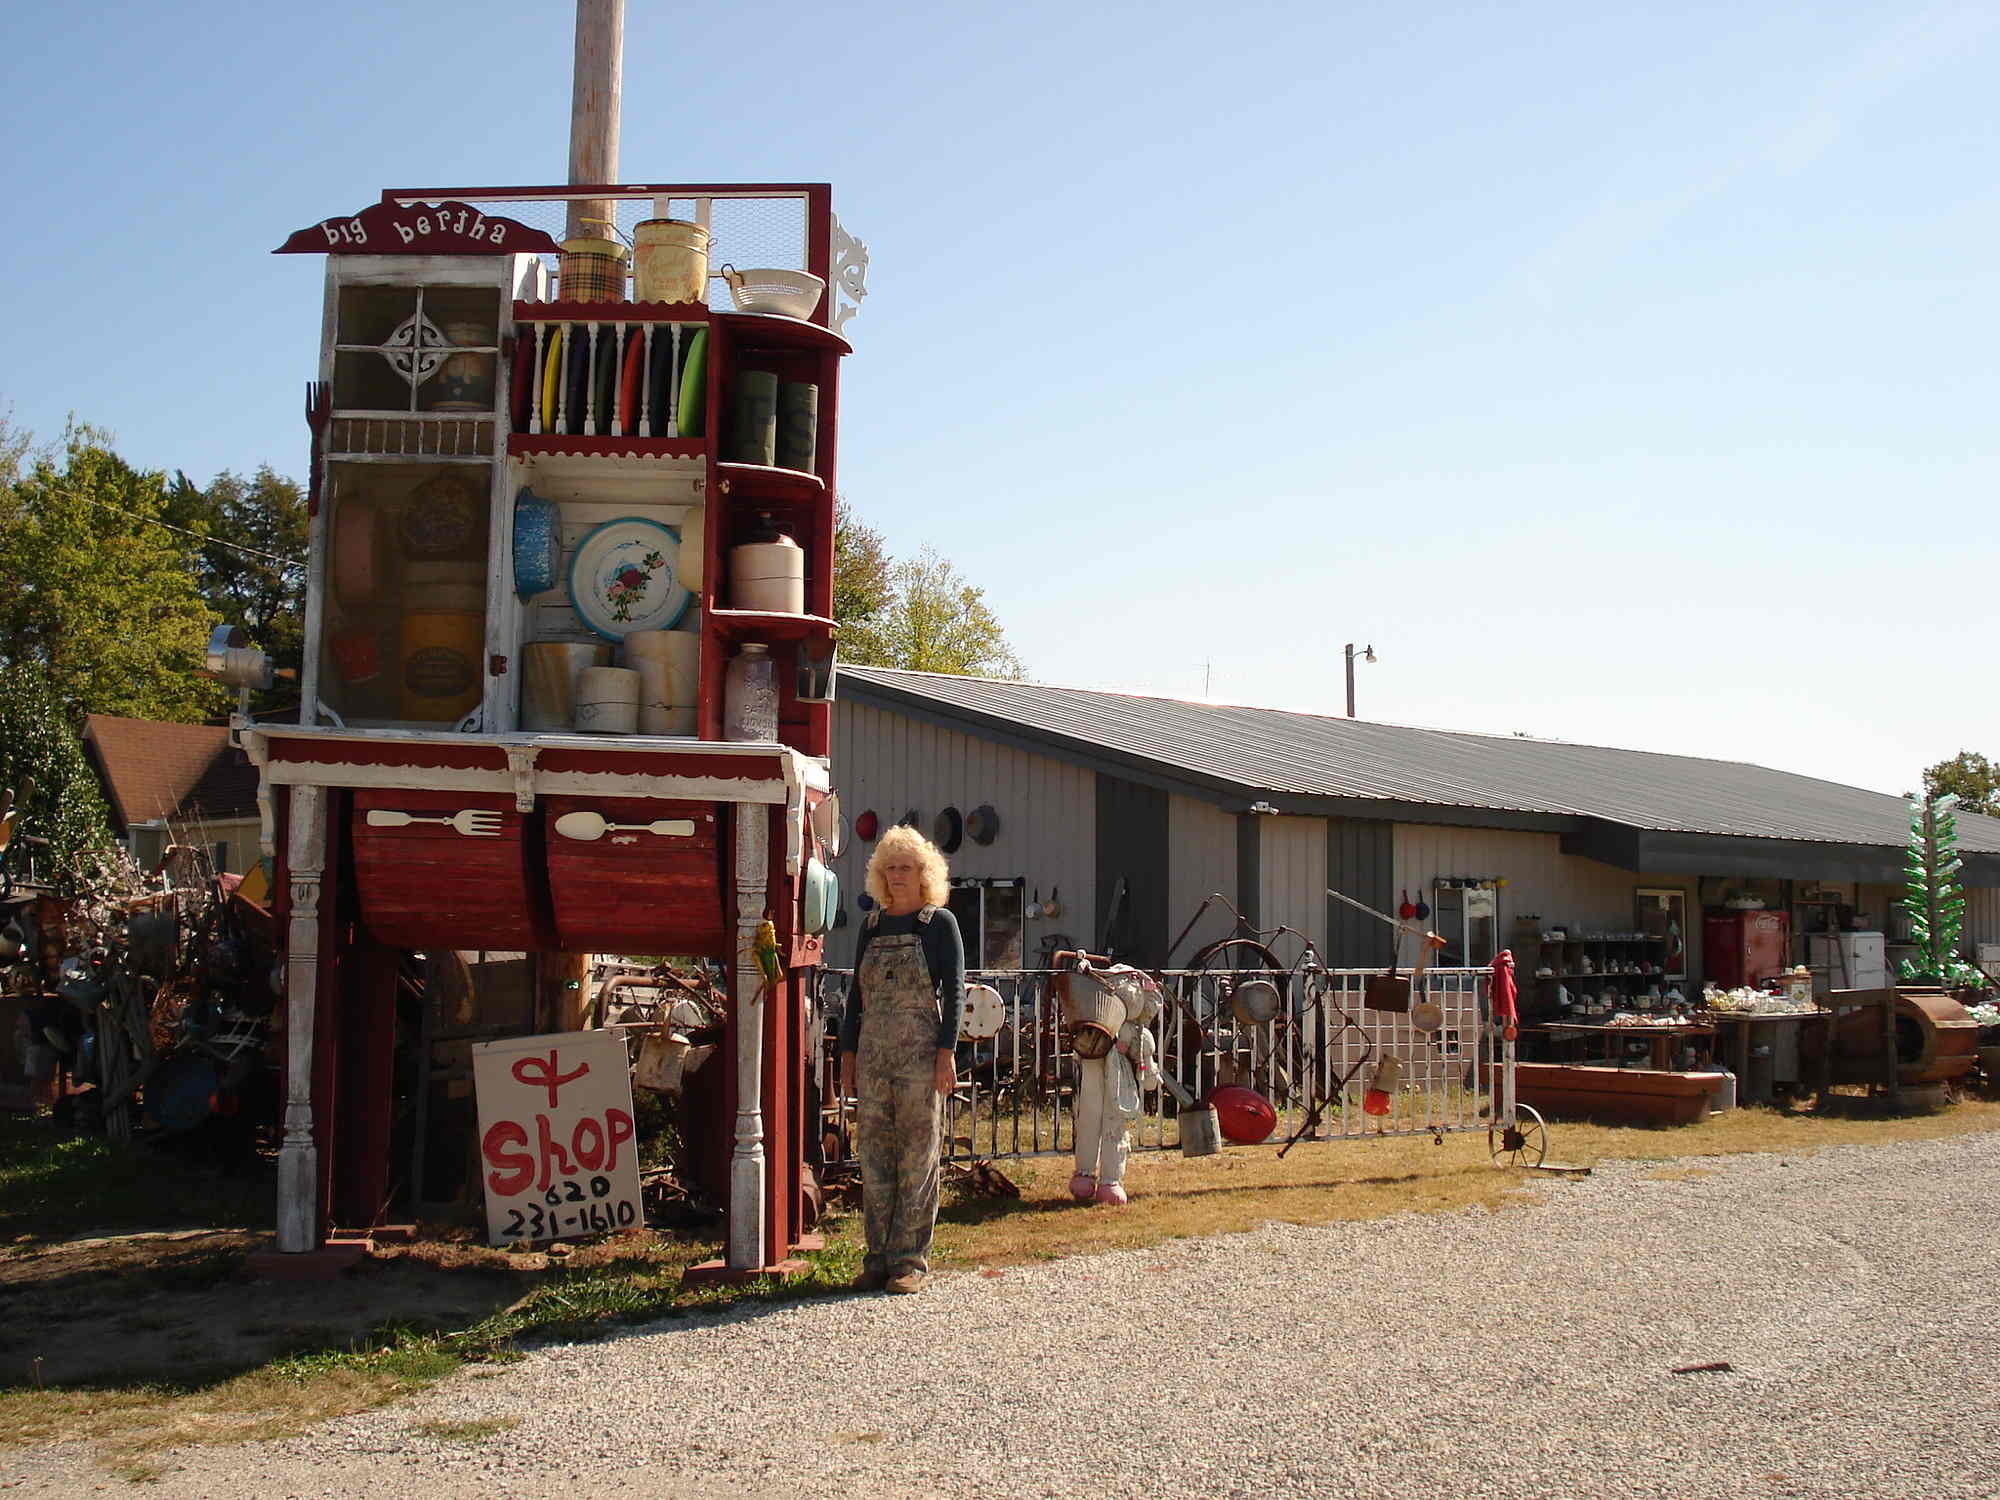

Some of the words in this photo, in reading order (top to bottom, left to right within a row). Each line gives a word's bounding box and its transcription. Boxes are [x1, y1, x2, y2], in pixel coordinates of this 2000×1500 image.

[320, 218, 368, 245] big
[393, 210, 506, 244] bertha
[545, 1175, 611, 1206] 620
[502, 1200, 636, 1238] 231-1610
